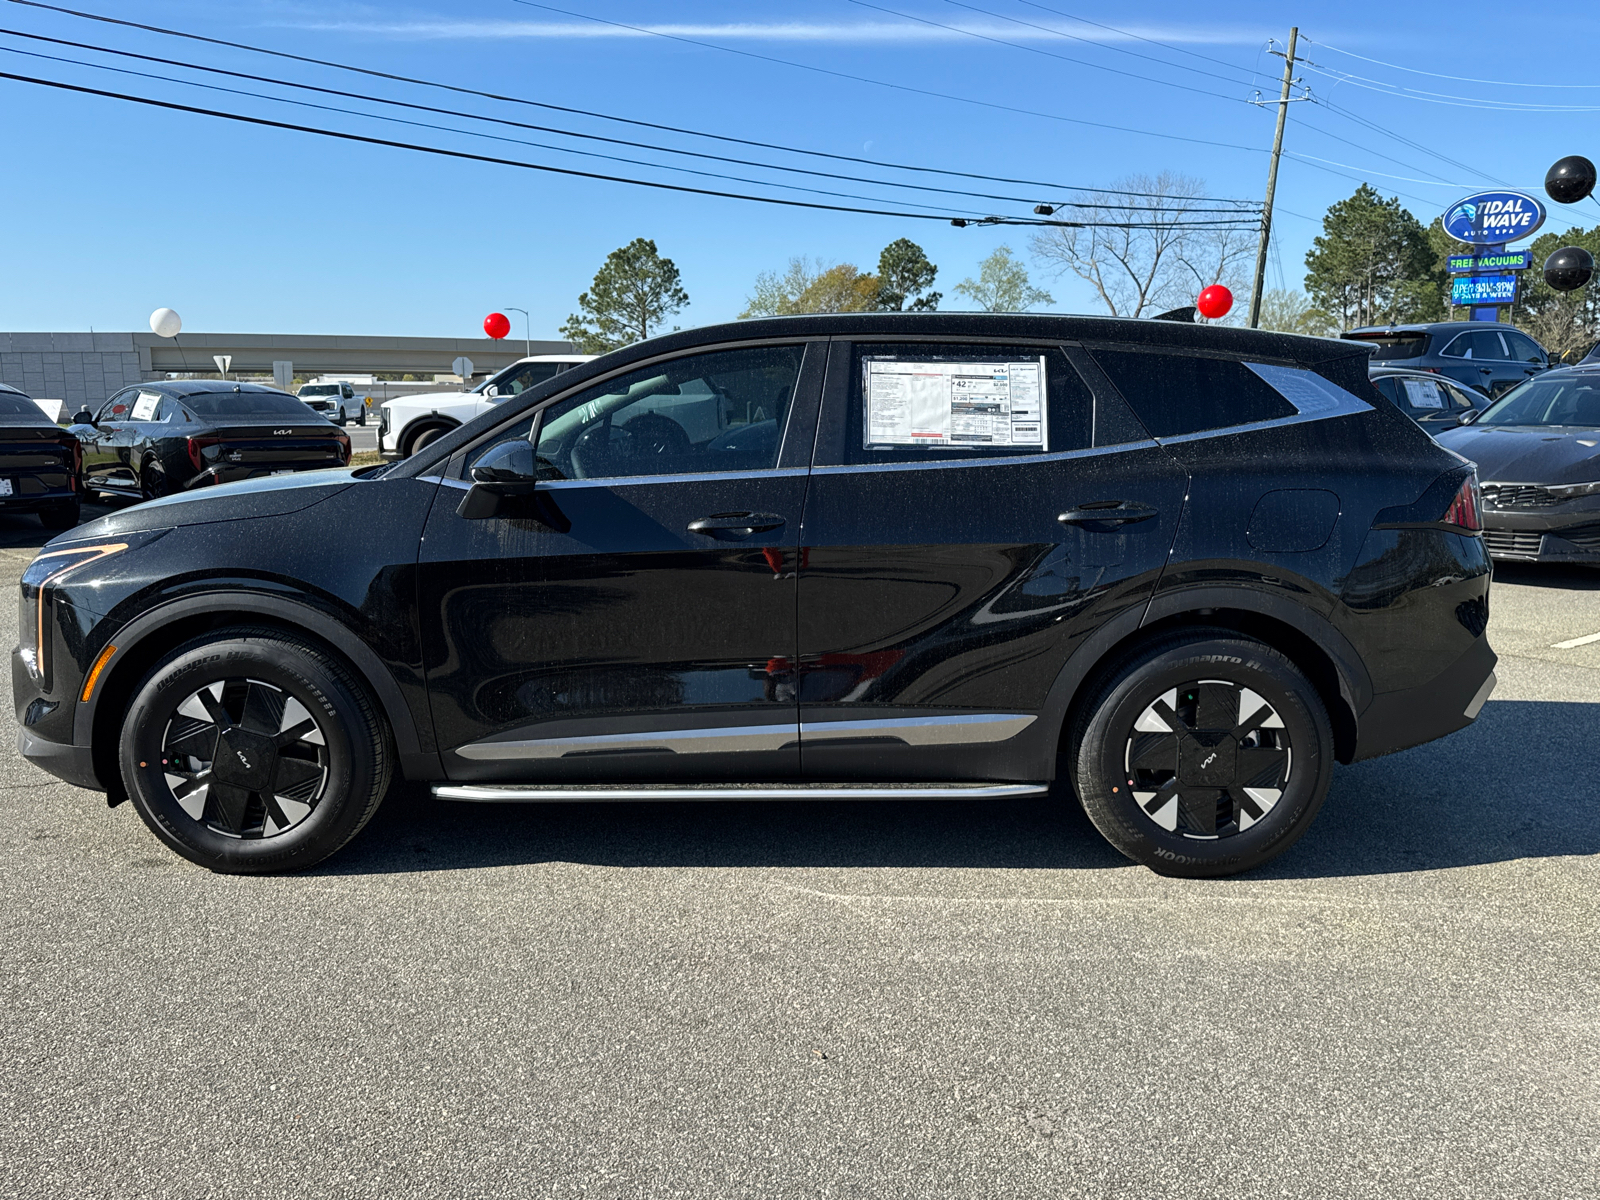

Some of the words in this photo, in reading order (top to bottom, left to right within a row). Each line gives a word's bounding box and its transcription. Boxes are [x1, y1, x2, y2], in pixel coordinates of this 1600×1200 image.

[1477, 199, 1523, 215] TIDAL
[1483, 212, 1533, 229] WAVE
[1463, 229, 1489, 237] AUTO
[1450, 258, 1475, 269] FREE
[1477, 254, 1524, 267] VACUUMS
[956, 380, 967, 388] 42
